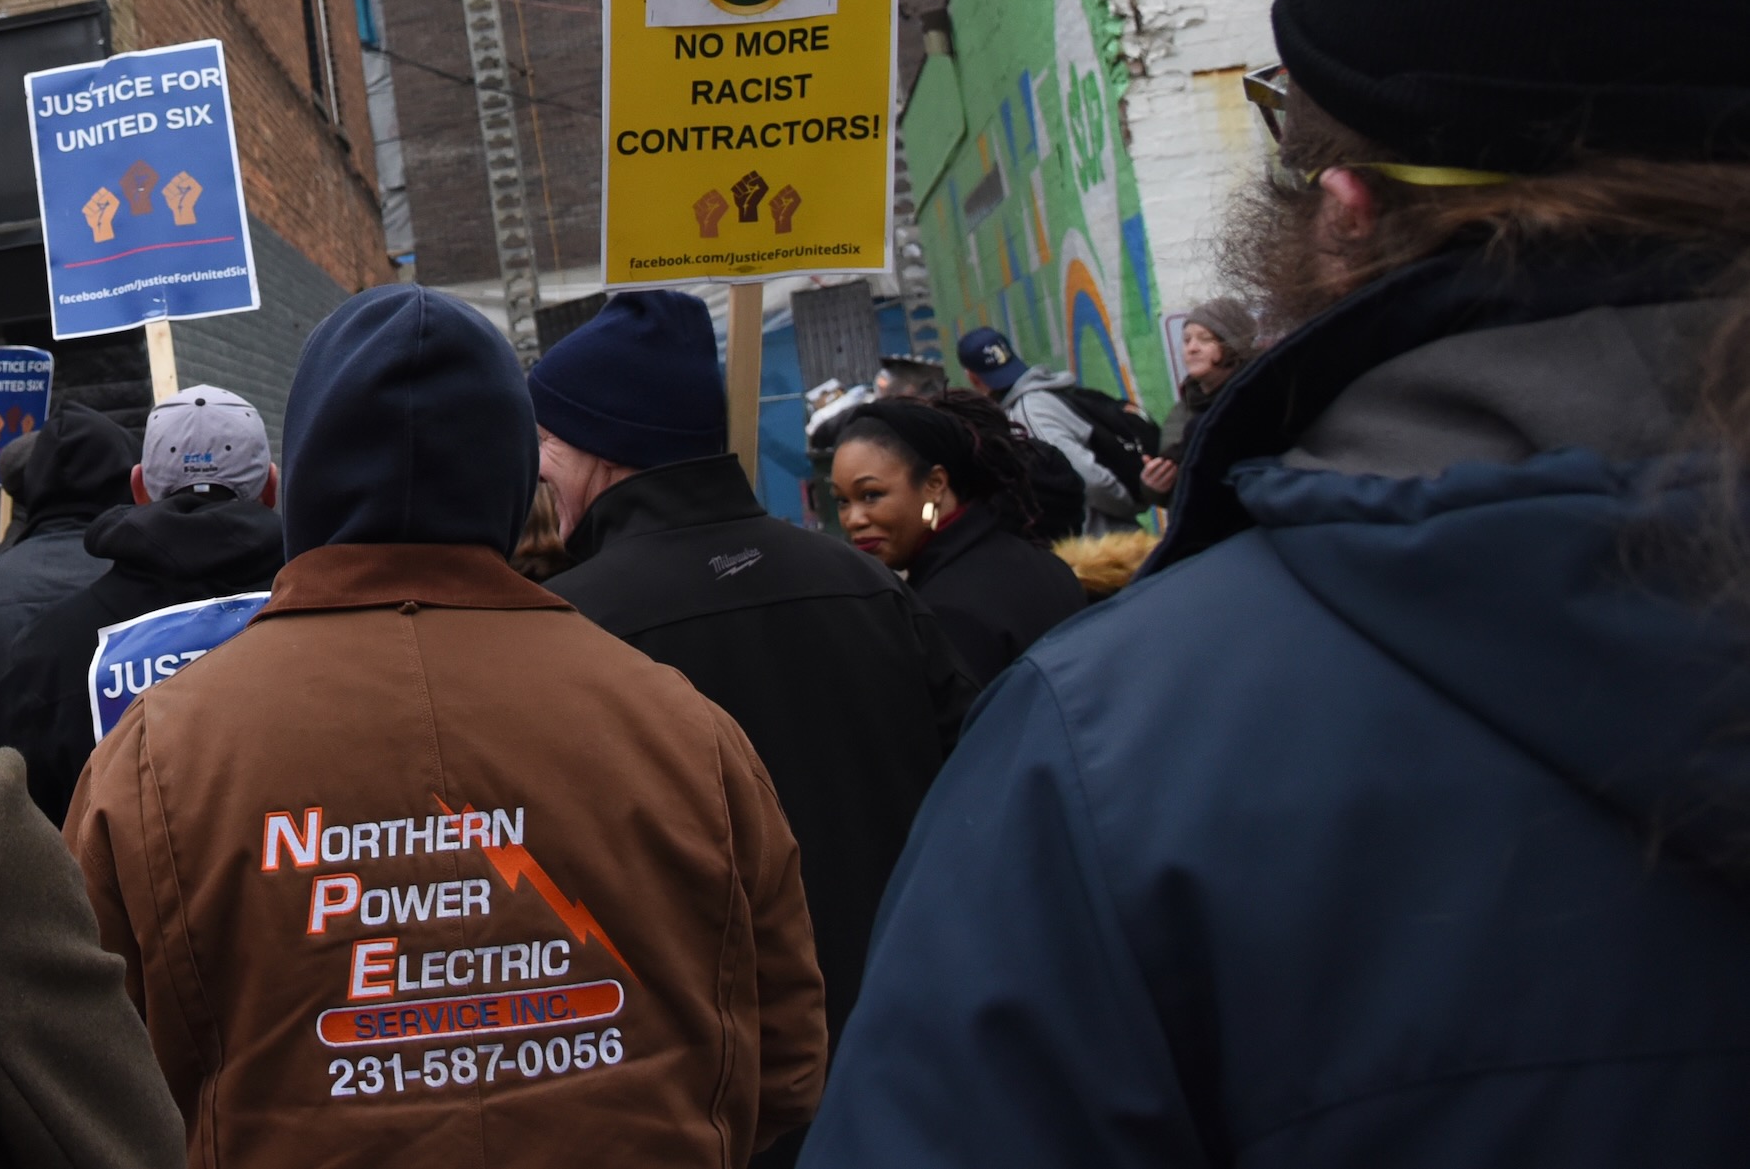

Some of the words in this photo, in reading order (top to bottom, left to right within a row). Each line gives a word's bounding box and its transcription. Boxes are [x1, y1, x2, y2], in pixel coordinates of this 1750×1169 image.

[674, 33, 724, 60] NO
[735, 26, 829, 57] MORE
[38, 76, 154, 117] JUSTICE
[161, 67, 222, 93] FOR
[691, 73, 812, 105] RACIST
[56, 112, 158, 152] UNITED
[166, 104, 213, 130] SIX
[616, 114, 880, 156] CONTRACTORS!
[629, 243, 861, 270] facebook.com/JusticeForUnitedSix
[261, 806, 525, 872] NORTHERN
[307, 872, 490, 934] POWER
[347, 937, 571, 1000] ELECTRIC
[354, 1000, 500, 1039] SERVICE
[511, 993, 578, 1024] INC.
[328, 1028, 624, 1097] 231-587-0056
